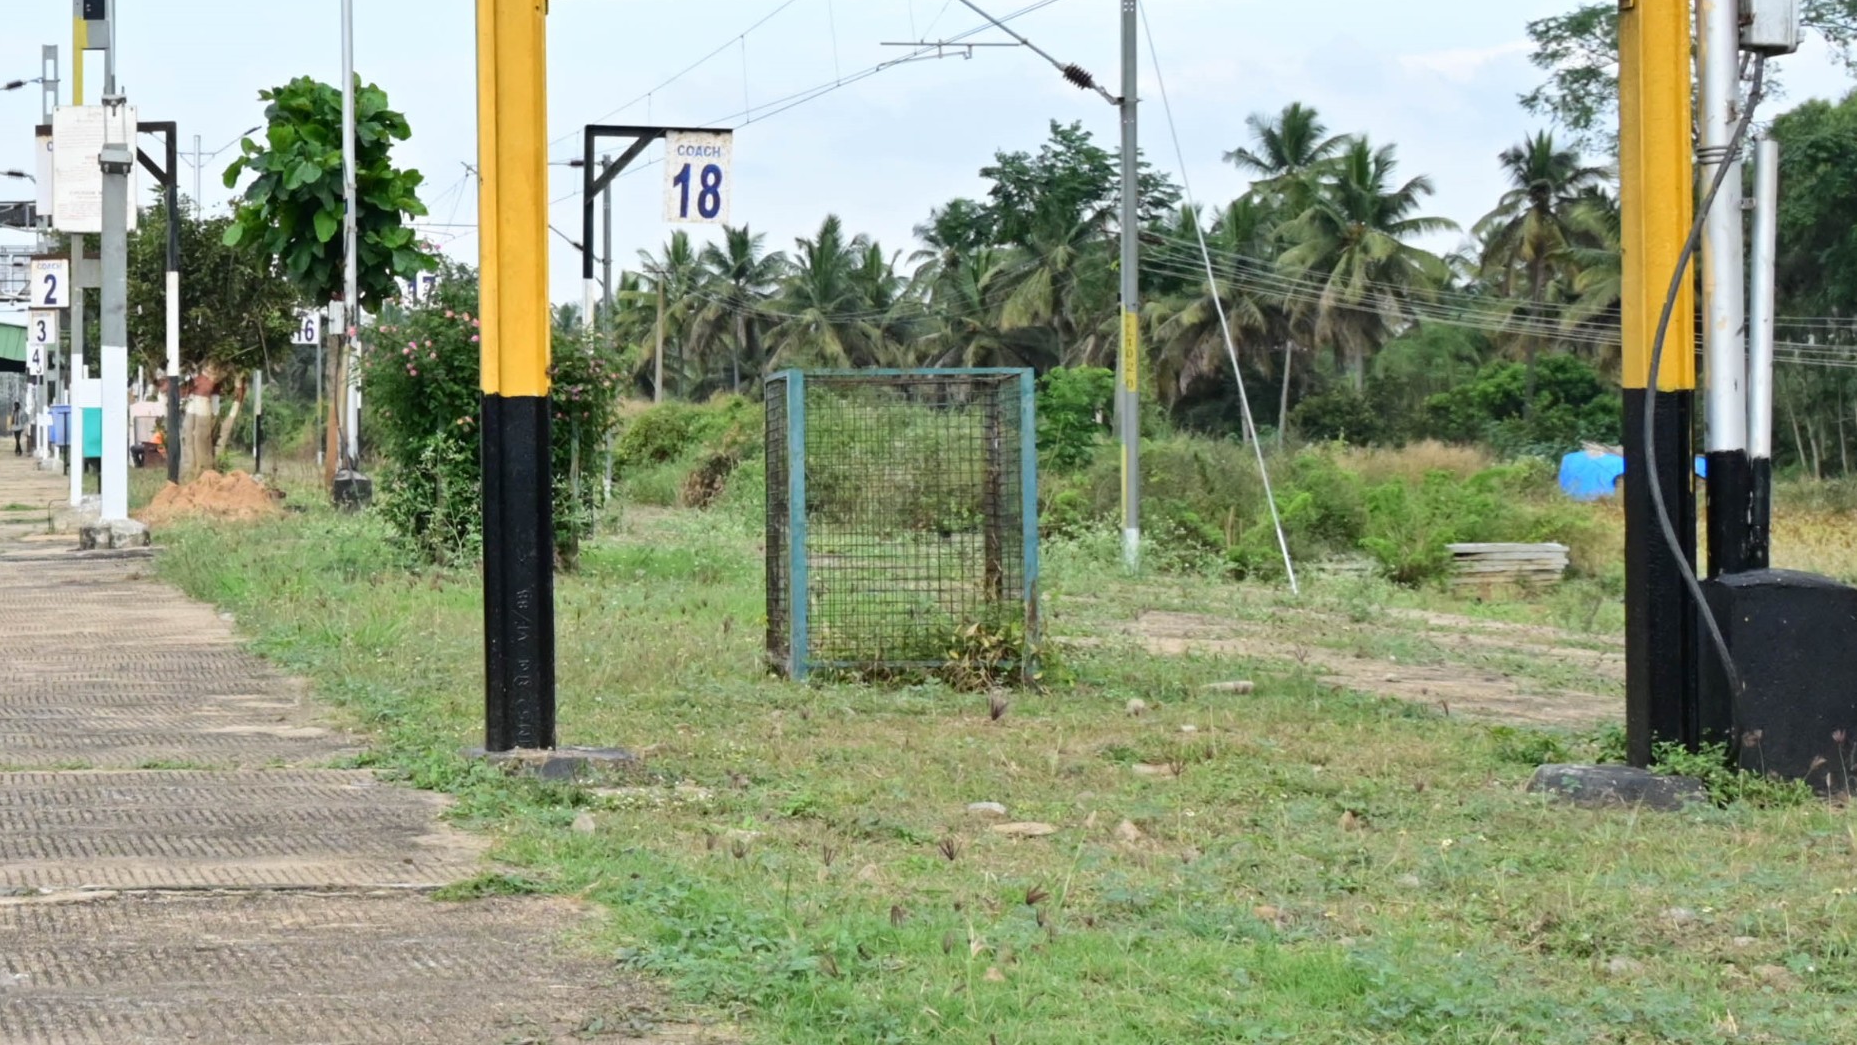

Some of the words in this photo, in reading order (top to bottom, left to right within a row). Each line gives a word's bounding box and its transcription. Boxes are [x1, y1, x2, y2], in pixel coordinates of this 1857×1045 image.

[677, 143, 721, 157] COACH
[673, 162, 722, 219] 18
[44, 274, 57, 305] 2
[407, 277, 436, 307] 17
[37, 320, 46, 342] 3
[32, 348, 40, 366] 4
